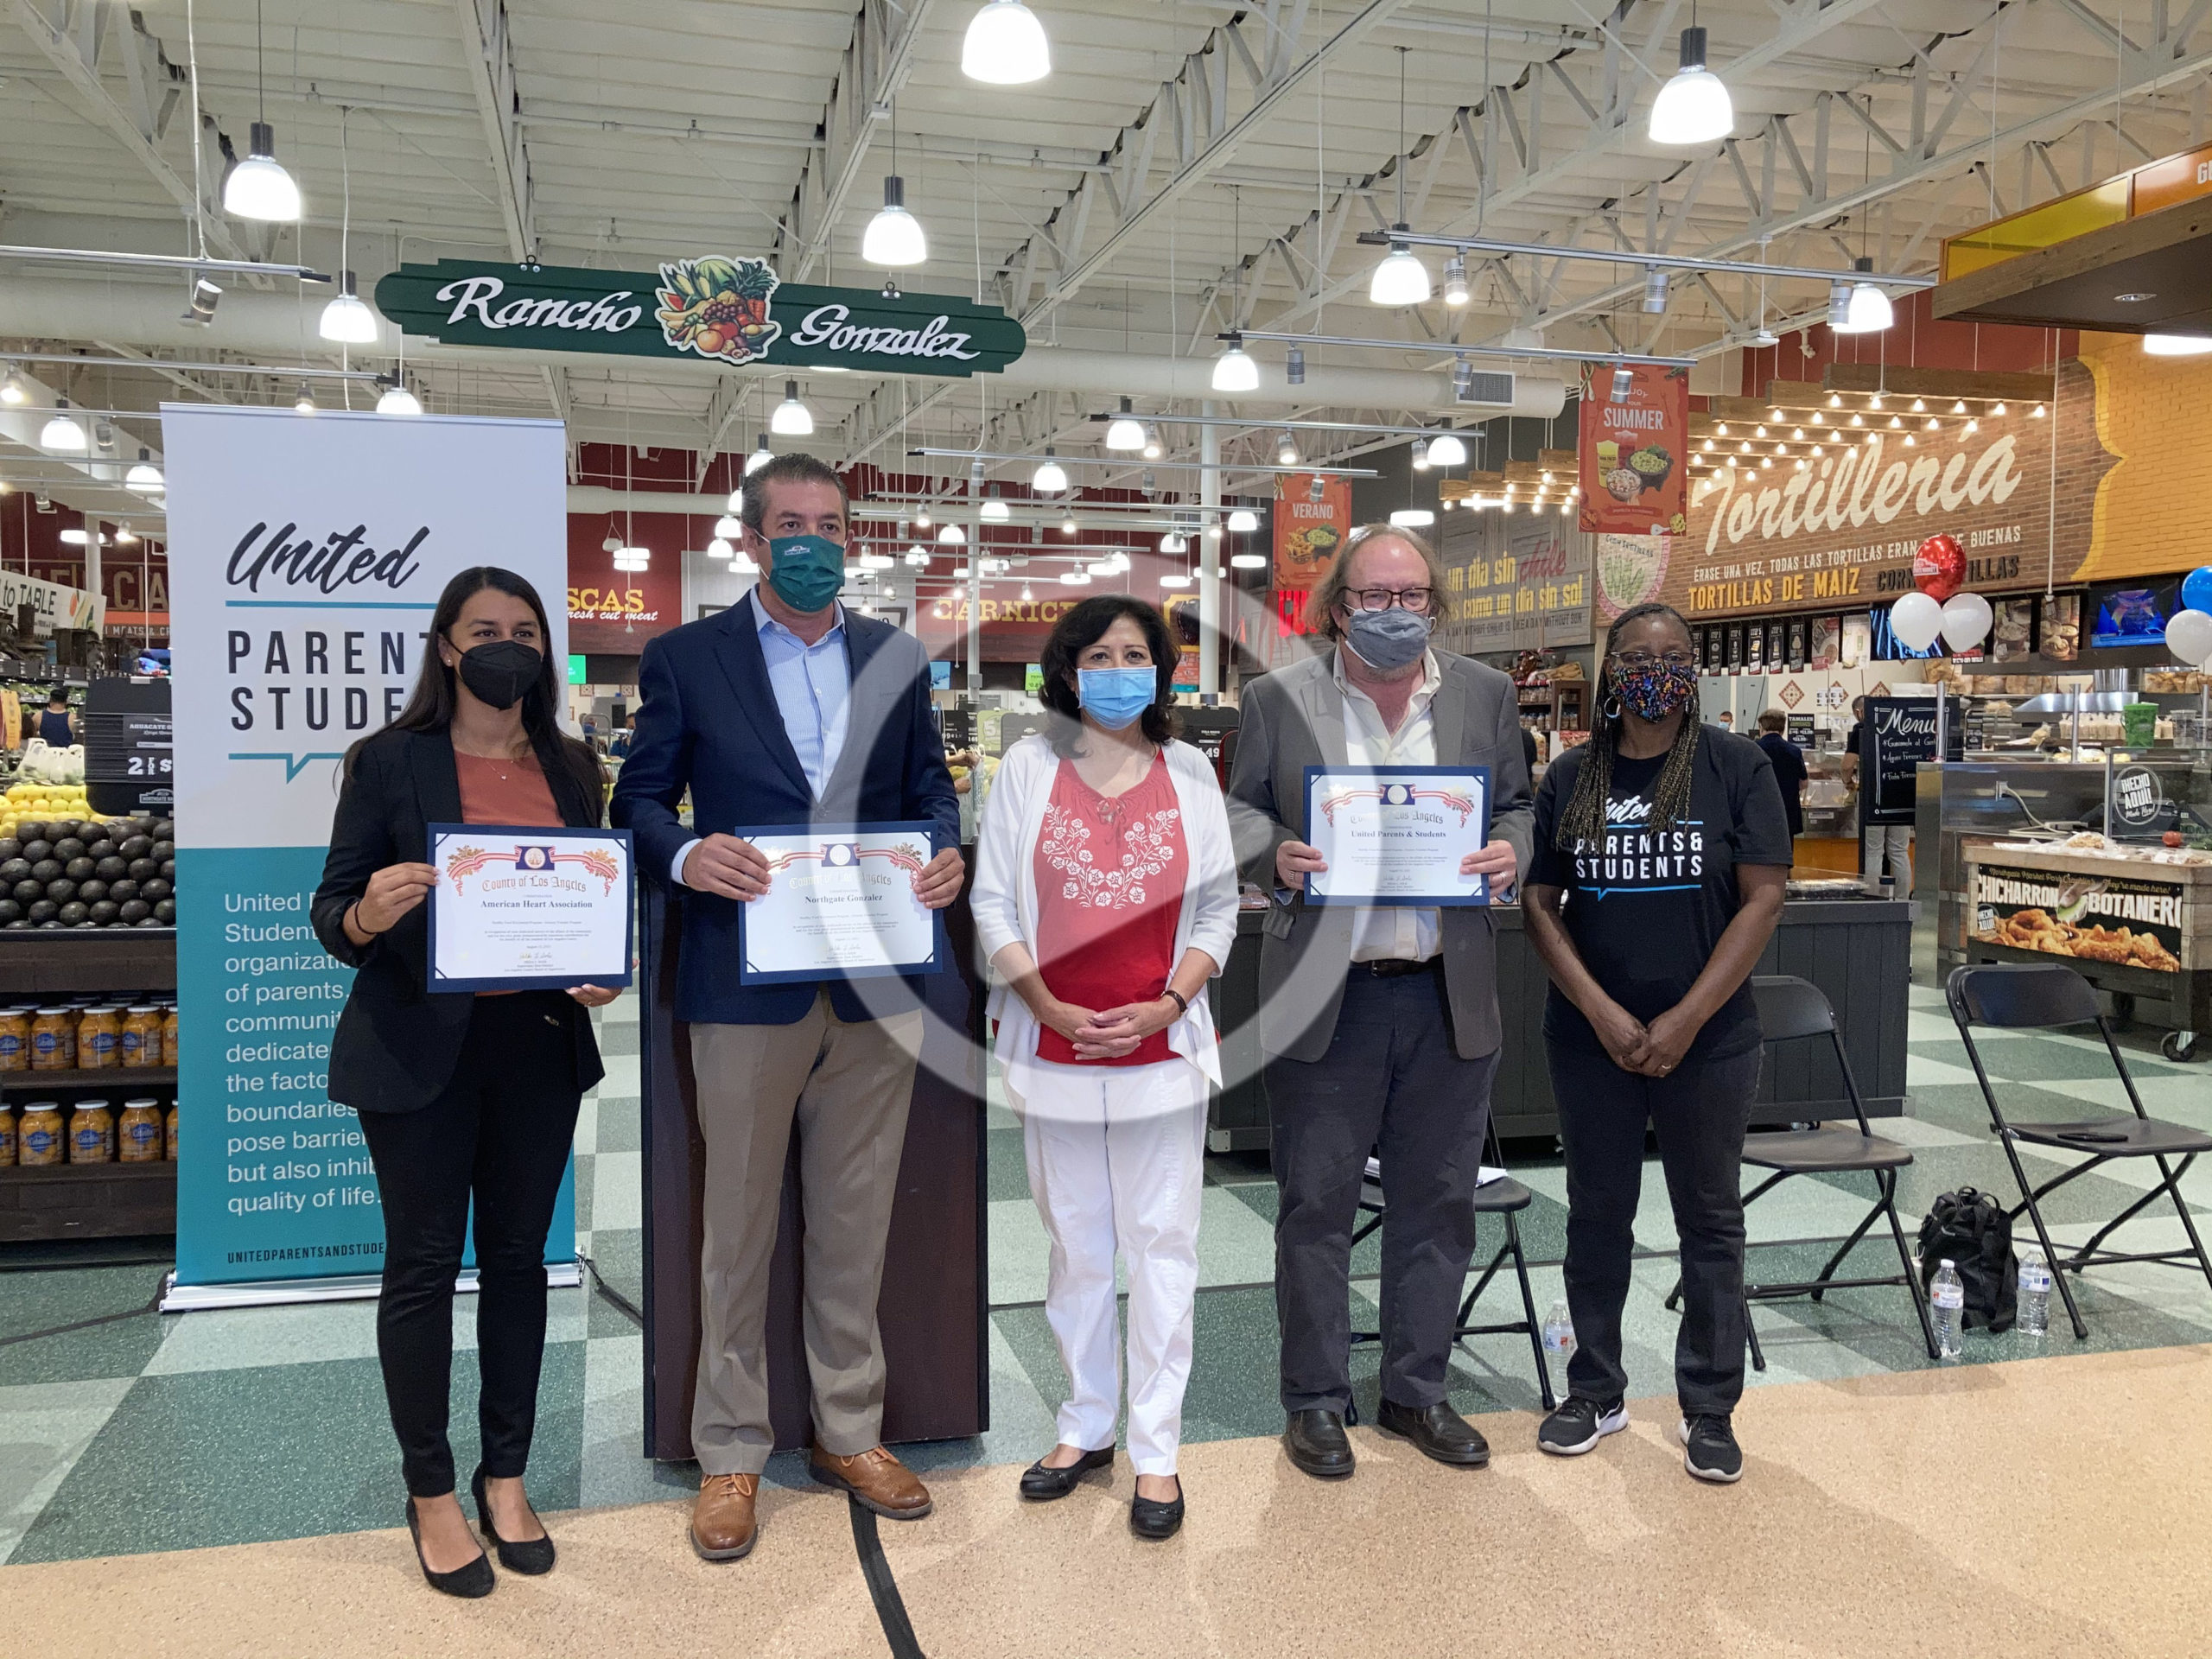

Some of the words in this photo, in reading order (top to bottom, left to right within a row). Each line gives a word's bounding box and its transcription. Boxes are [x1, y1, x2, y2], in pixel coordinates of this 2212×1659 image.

[435, 276, 642, 333] Rancho
[790, 304, 981, 360] Gonzalez
[1604, 408, 1663, 430] SUMMER
[1292, 503, 1333, 519] VERANO
[226, 522, 430, 594] United
[1724, 565, 1741, 579] UNA
[1745, 561, 1765, 576] VEZ,
[1770, 556, 1798, 573] TODAS
[1804, 553, 1822, 569] LAS
[1827, 545, 1883, 566] TORTILLAS
[1888, 540, 1917, 558] ERAN
[1970, 525, 2022, 548] BUENAS
[1494, 550, 1516, 585] sin
[3, 580, 16, 608] to
[20, 583, 57, 616] TABLE
[1464, 596, 1492, 620] como
[1497, 594, 1511, 615] un
[1539, 582, 1557, 610] sin
[1562, 574, 1583, 607] sol
[1688, 578, 1772, 612] TORTILLAS
[1782, 575, 1804, 602] DE
[1814, 562, 1860, 599] MAÍZ
[1877, 568, 1916, 591] CORN
[568, 588, 645, 613] SCAS
[568, 607, 595, 620] resh
[600, 610, 621, 620] cut
[624, 610, 658, 621] meat
[1876, 708, 1937, 736] Menu
[128, 756, 143, 775] 2
[160, 758, 172, 773] $
[1575, 855, 1702, 880] STUDENTS
[482, 877, 516, 892] County
[519, 876, 527, 887] of
[530, 875, 549, 888] Los
[552, 876, 587, 893] Angeles
[225, 893, 301, 912] United
[480, 899, 520, 909] American
[523, 899, 546, 909] Heart
[549, 899, 593, 909] Association
[805, 894, 845, 905] Northgate
[847, 893, 883, 903] Gonzalez
[225, 922, 318, 944] Student
[226, 983, 250, 1003] of
[226, 1073, 264, 1093] the
[270, 1071, 329, 1091] facto
[227, 1100, 359, 1123] boundaries
[227, 1136, 286, 1158] pose
[228, 1163, 267, 1184] but
[272, 1160, 321, 1181] also
[228, 1192, 306, 1217] quality
[312, 1188, 336, 1209] of
[341, 1186, 382, 1206] life.
[227, 1241, 385, 1265] UNITEDPARENTSANDSTUDE
